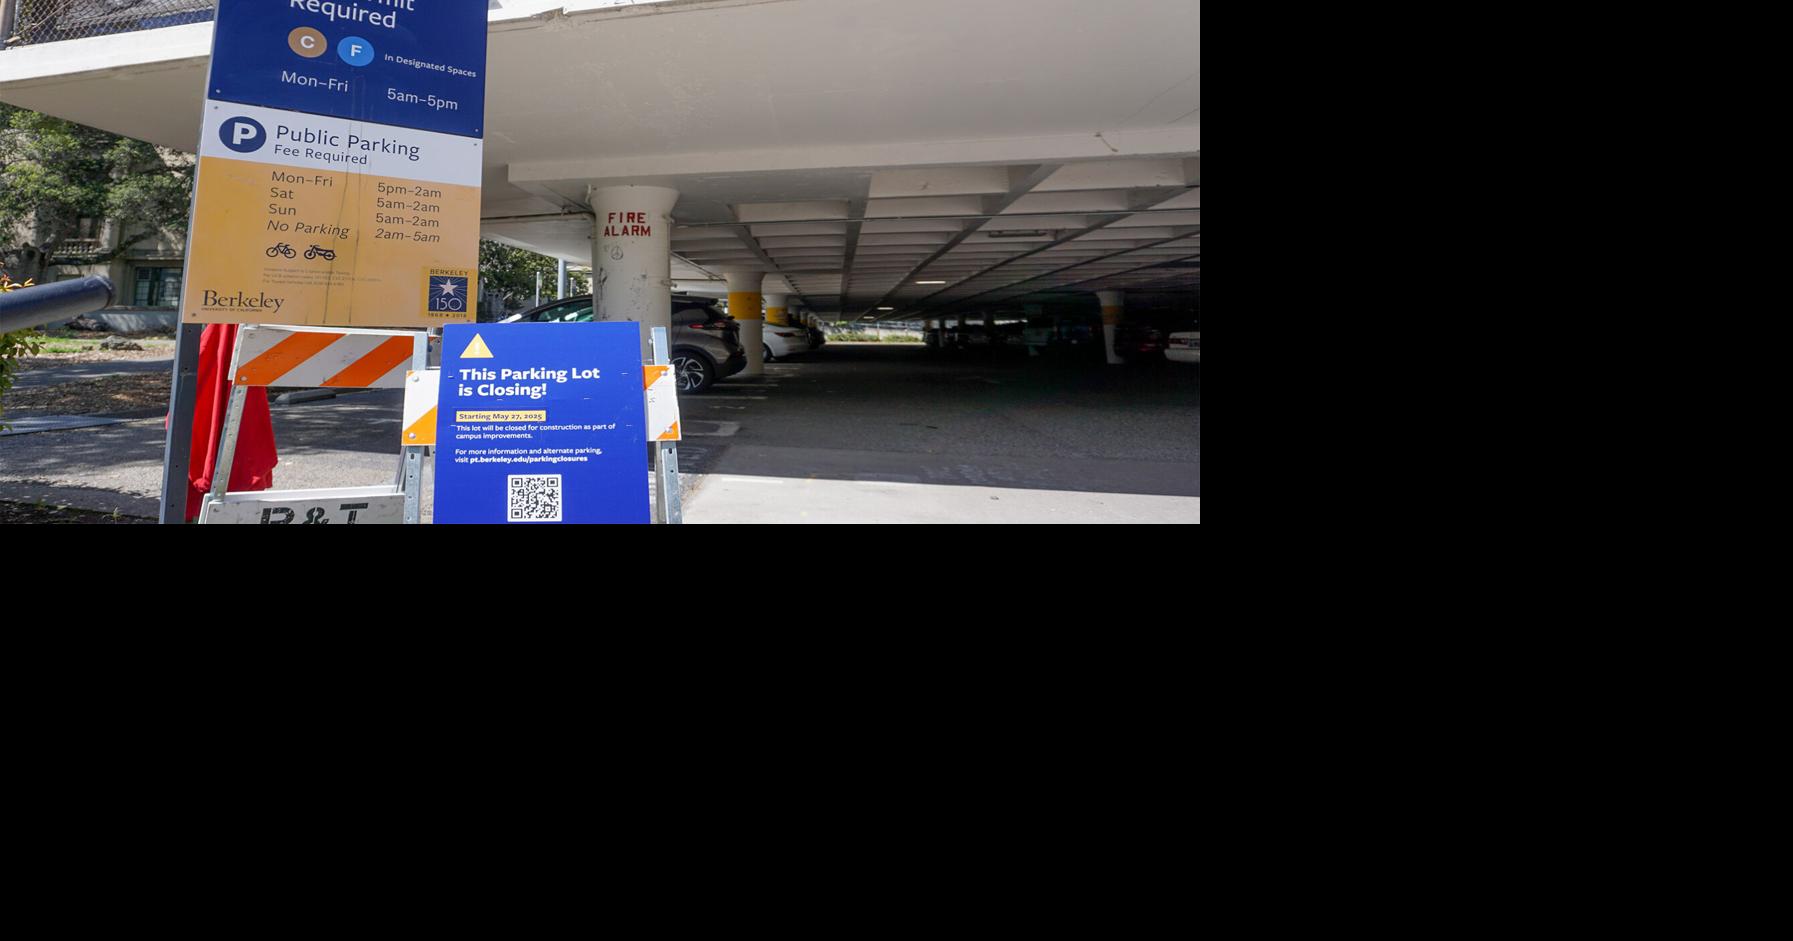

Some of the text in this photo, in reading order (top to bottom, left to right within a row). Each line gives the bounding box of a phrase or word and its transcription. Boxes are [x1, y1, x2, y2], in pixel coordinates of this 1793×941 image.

[300, 35, 363, 57] C F
[384, 53, 477, 78] In Designated Spaces
[232, 121, 258, 145] P
[276, 125, 420, 161] Public Parking
[274, 144, 368, 165] Fee Required
[270, 187, 294, 200] Sat
[268, 203, 297, 216] Sun
[608, 212, 647, 224] FIRE
[266, 219, 350, 240] No Parking
[604, 225, 651, 237] ALARM
[430, 268, 469, 276] BERKELEY
[202, 289, 285, 314] Berkeley
[436, 297, 462, 311] 150
[459, 367, 601, 383] This Parking Lot
[458, 383, 547, 399] is Closing!
[459, 413, 491, 422] Starting
[492, 413, 509, 421] May
[482, 432, 533, 440] improvements.
[575, 447, 602, 455] parking,
[469, 455, 588, 464] pt.berkeley.edu/parkingclosures
